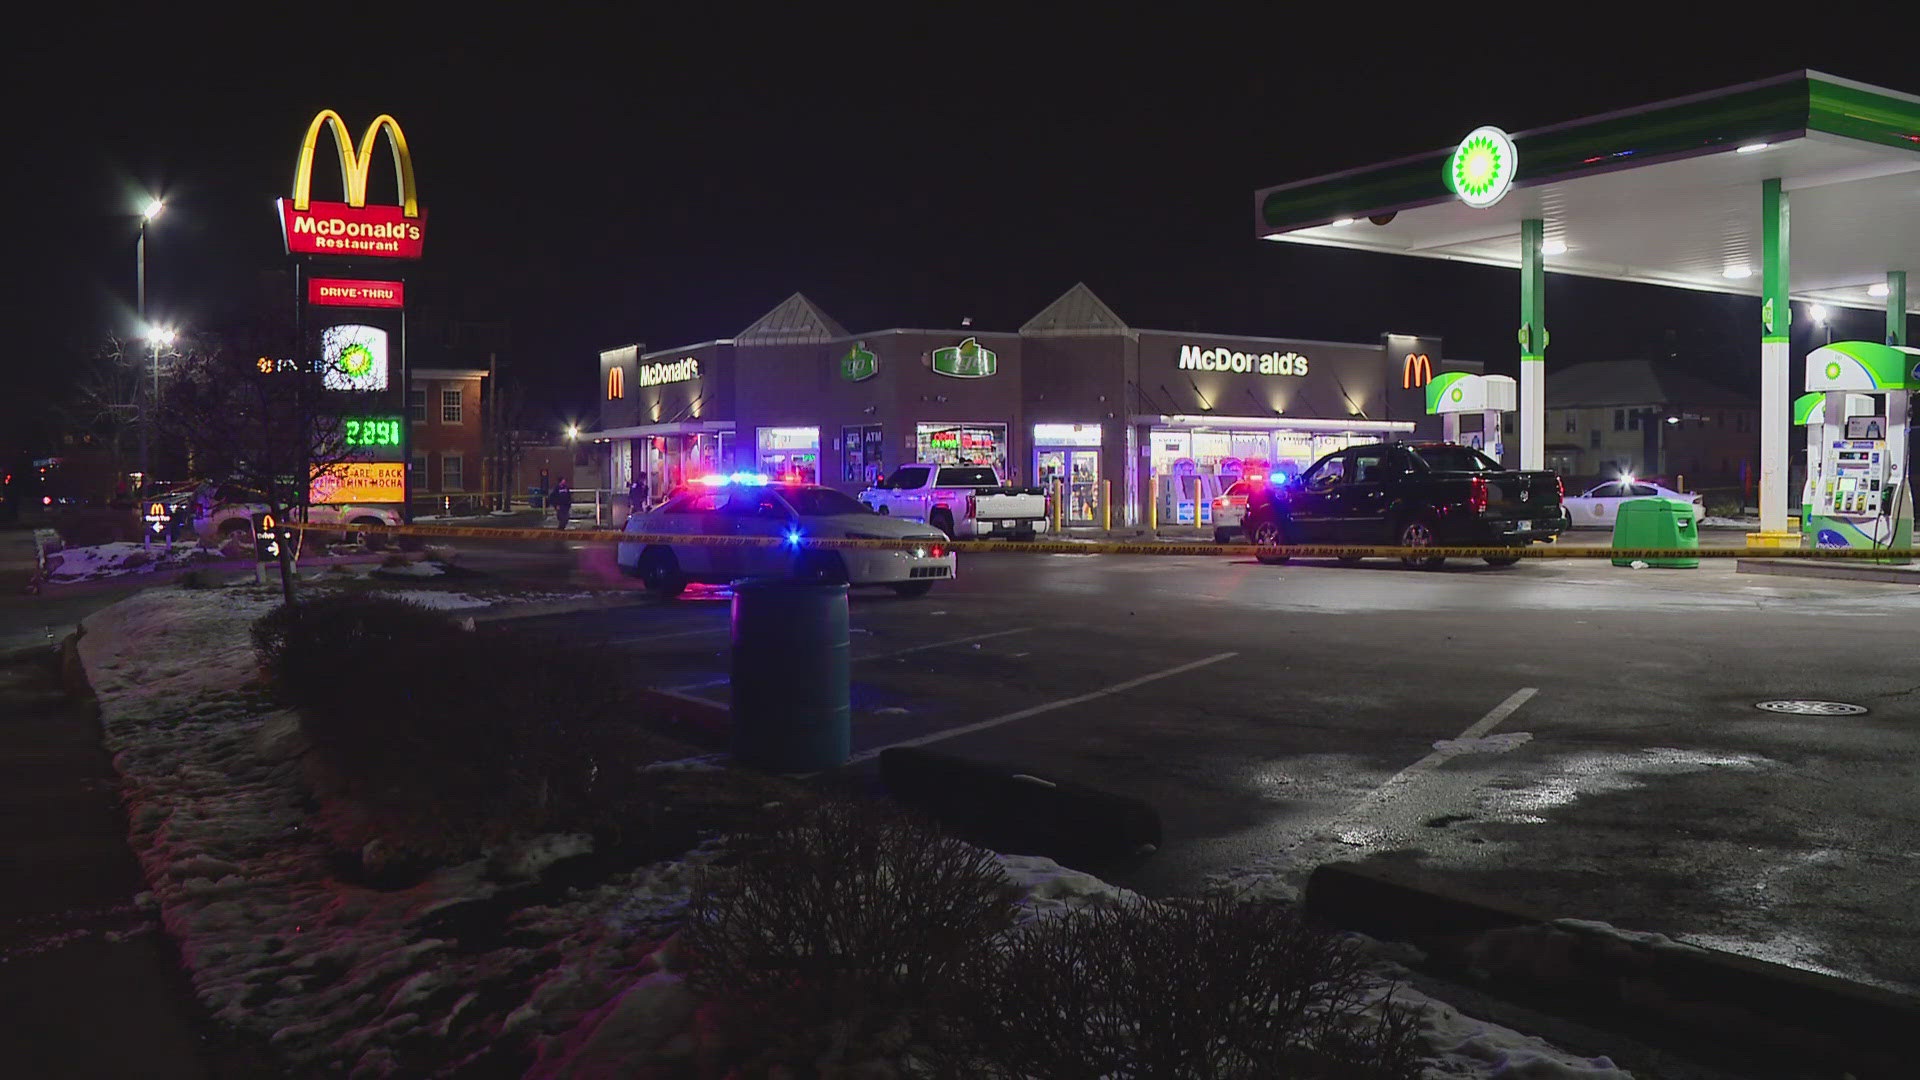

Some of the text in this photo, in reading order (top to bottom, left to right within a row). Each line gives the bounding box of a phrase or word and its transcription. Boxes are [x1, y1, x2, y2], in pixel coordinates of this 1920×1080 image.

[294, 216, 420, 240] McDonald's
[315, 236, 399, 252] Restaurant
[1178, 345, 1309, 376] McDonald's
[640, 357, 699, 387] McDonald's
[866, 431, 882, 443] ATM
[354, 469, 370, 478] ARE
[379, 469, 403, 479] BACK
